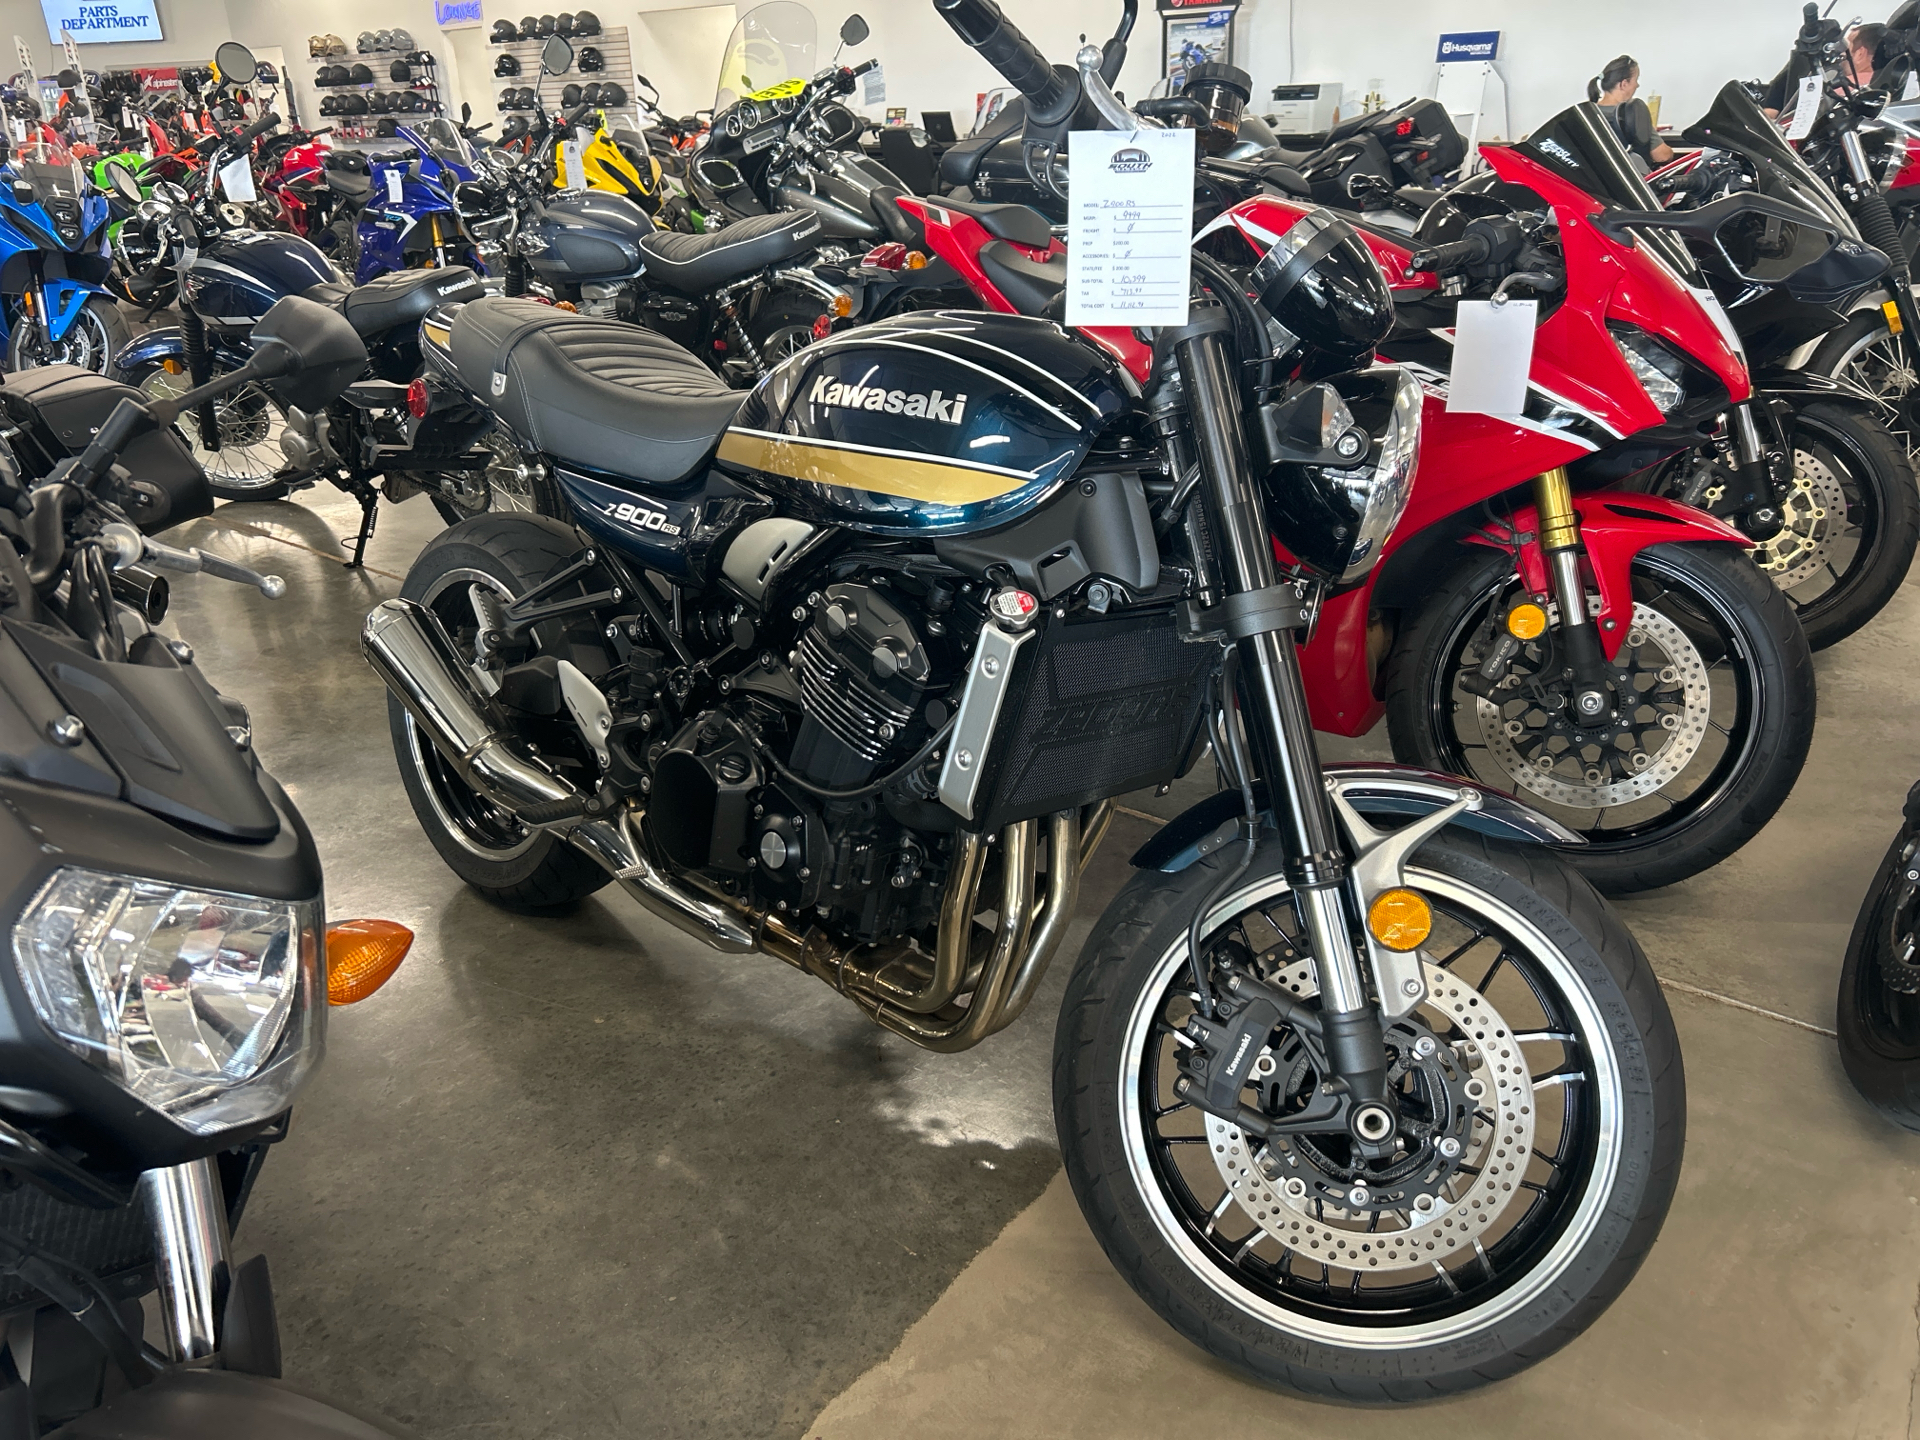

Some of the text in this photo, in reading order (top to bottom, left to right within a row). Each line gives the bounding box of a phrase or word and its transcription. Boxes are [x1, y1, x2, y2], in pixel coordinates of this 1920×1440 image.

[79, 6, 118, 17] PARTS
[61, 16, 149, 30] DEPARTMENT
[1451, 43, 1492, 52] Husqvarna
[1108, 162, 1153, 170] SOUTH
[436, 276, 477, 297] Kawasaki
[808, 374, 968, 426] Kawasaki
[1688, 475, 1706, 501] TOKICO
[662, 524, 680, 535] RS
[1488, 640, 1511, 673] TOKICO
[1225, 1033, 1252, 1077] Kawasaki
